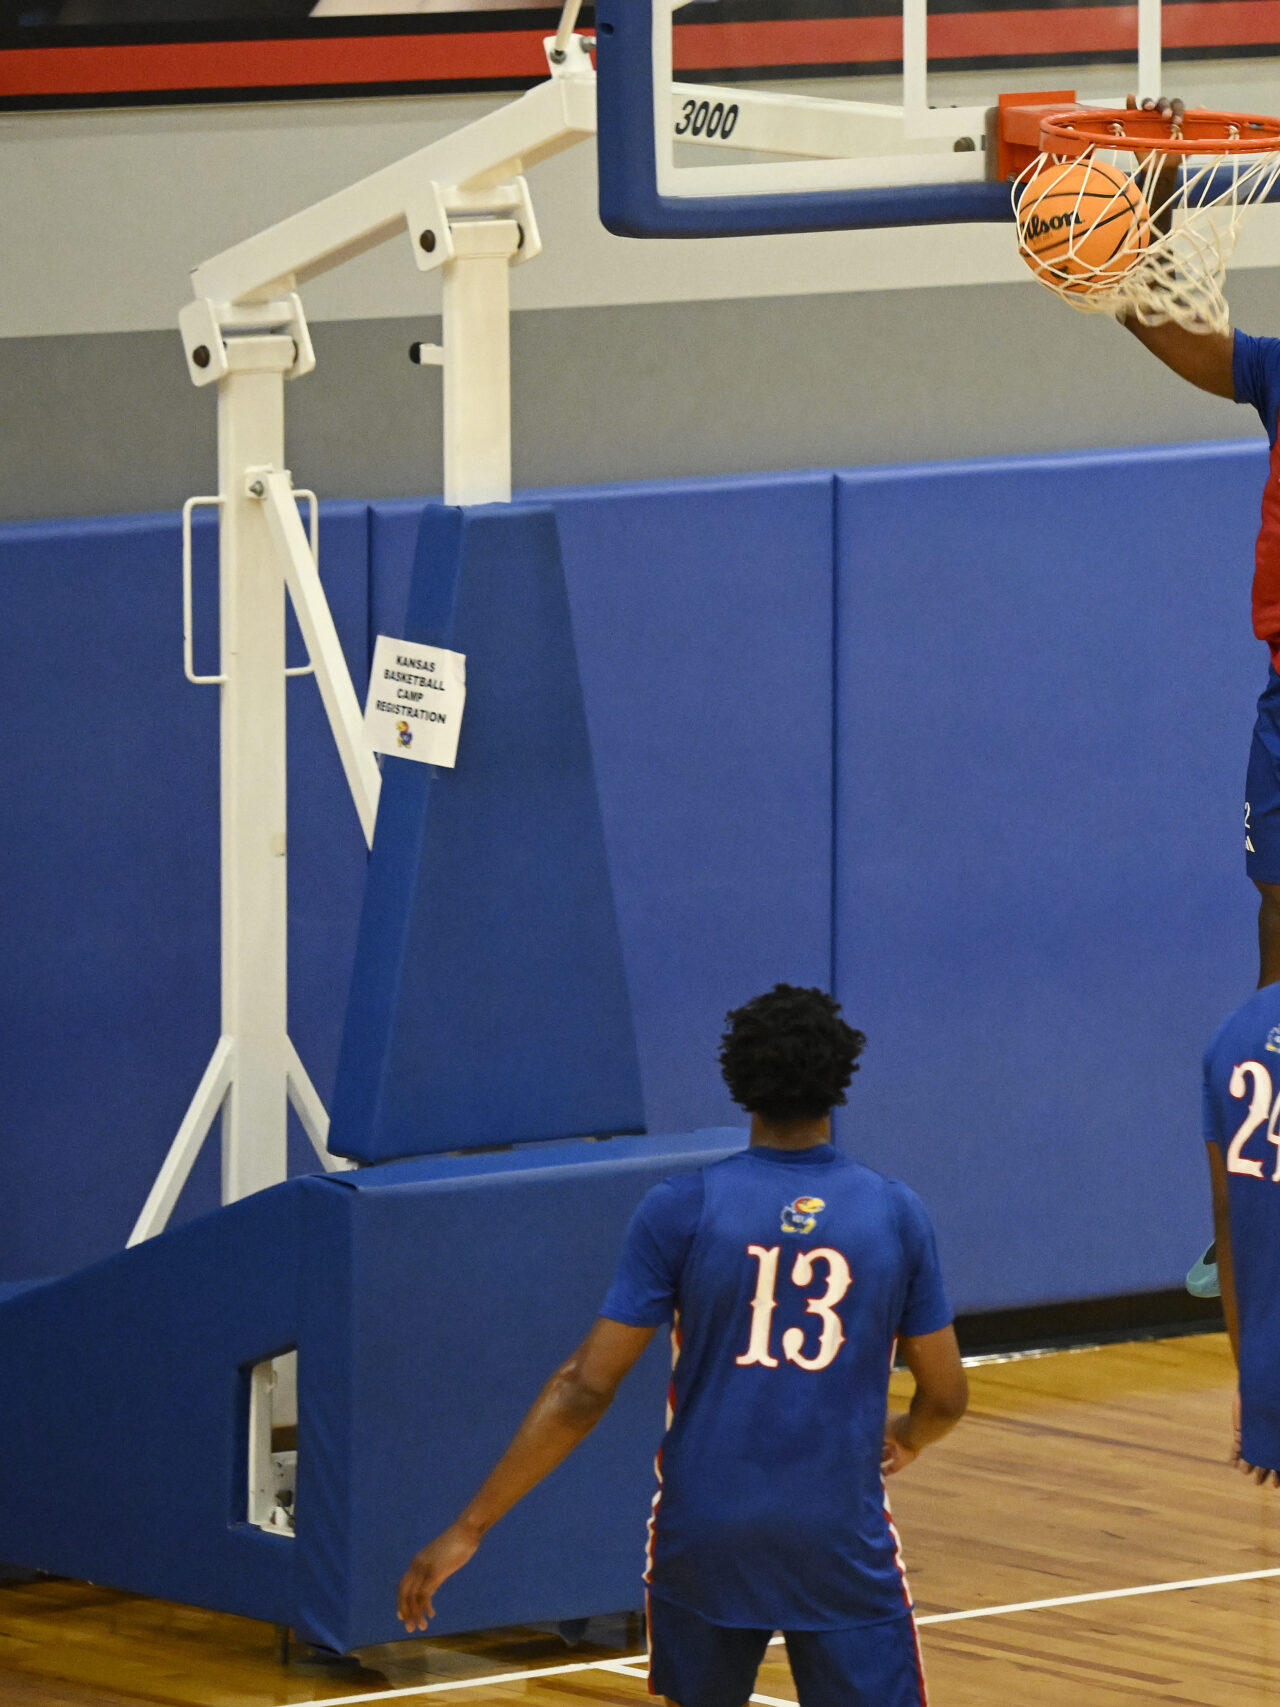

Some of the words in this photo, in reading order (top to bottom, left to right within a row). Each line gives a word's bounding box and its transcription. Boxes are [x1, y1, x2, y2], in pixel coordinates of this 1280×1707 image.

[675, 99, 739, 140] 3000
[396, 655, 436, 673] KANSAS
[383, 668, 446, 691] BASKETBALL
[396, 688, 424, 702] CAMP
[376, 700, 447, 724] REGISTRATION
[735, 1245, 853, 1372] 13
